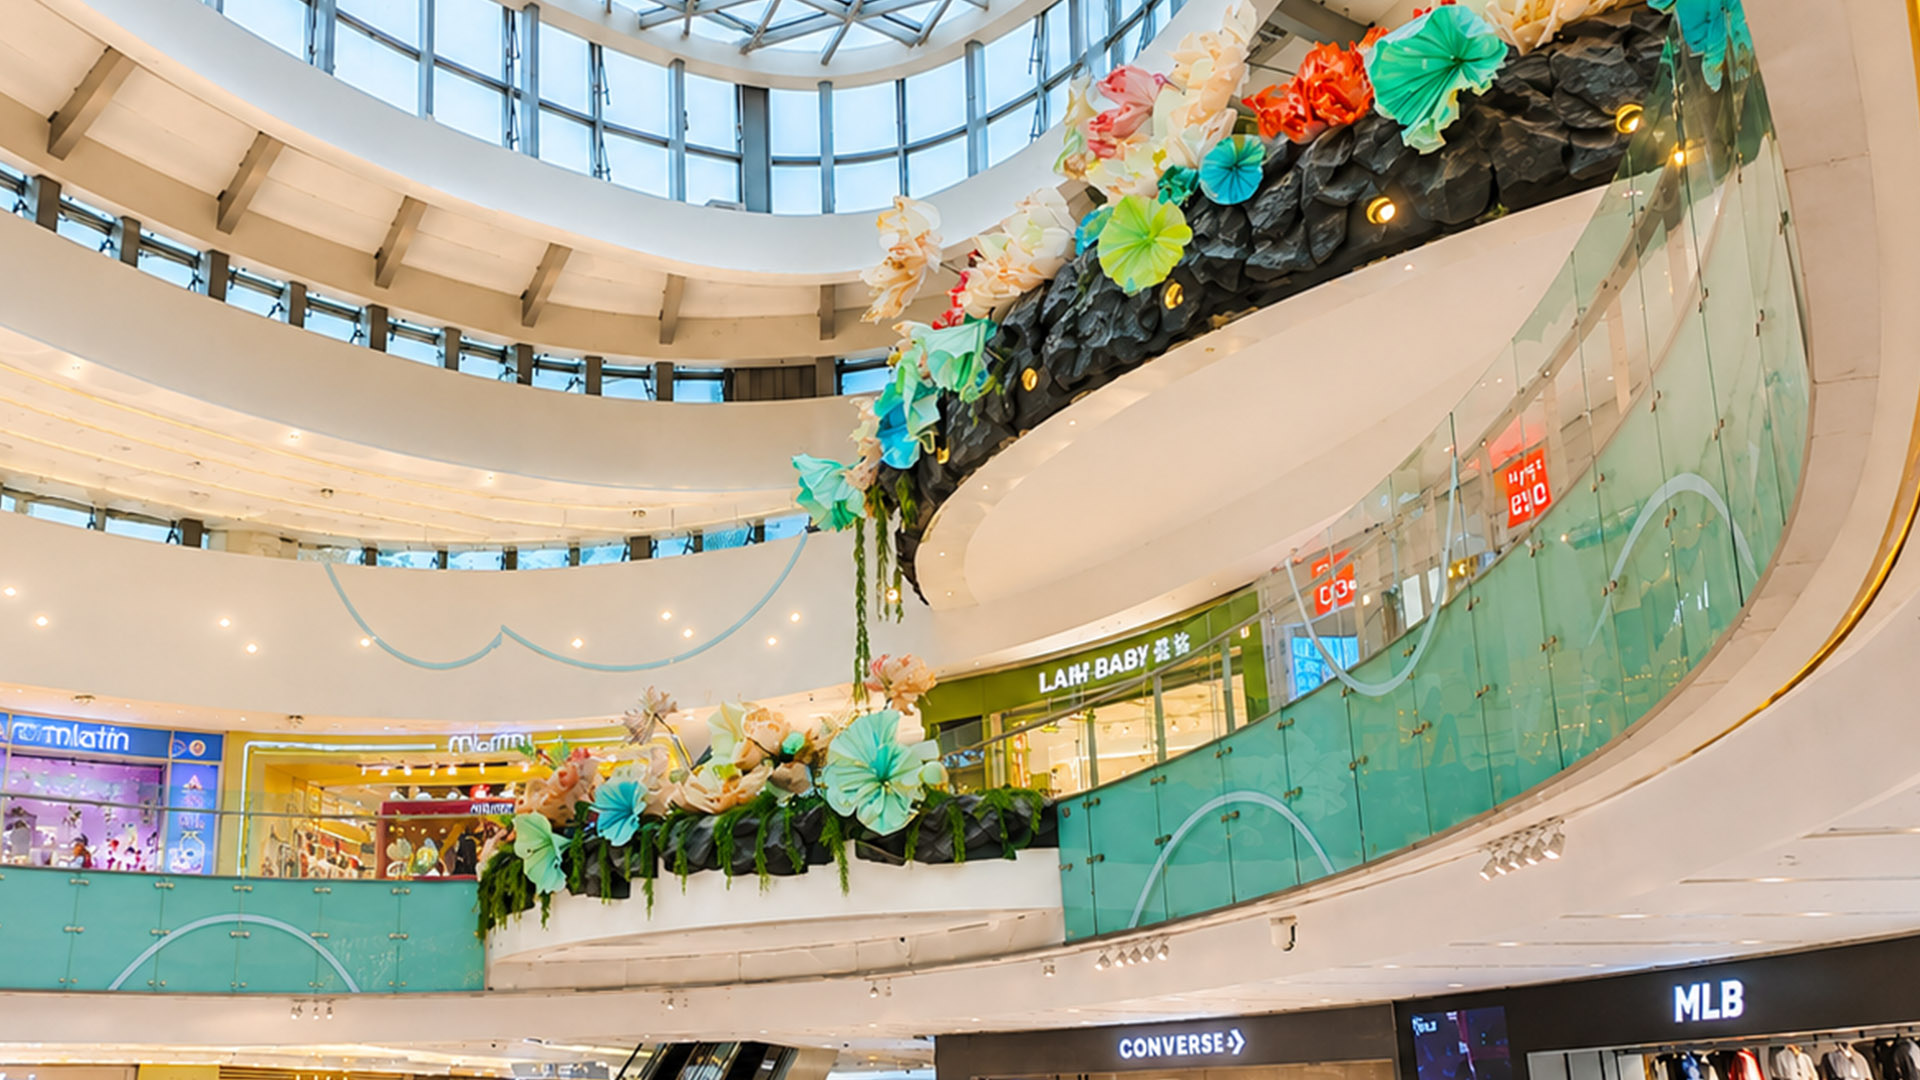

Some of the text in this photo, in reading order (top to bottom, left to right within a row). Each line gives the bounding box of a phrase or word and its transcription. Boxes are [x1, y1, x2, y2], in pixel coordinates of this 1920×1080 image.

[1095, 644, 1149, 680] BABY
[1674, 979, 1744, 1023] MLB
[1119, 1032, 1224, 1059] CONVERSE
